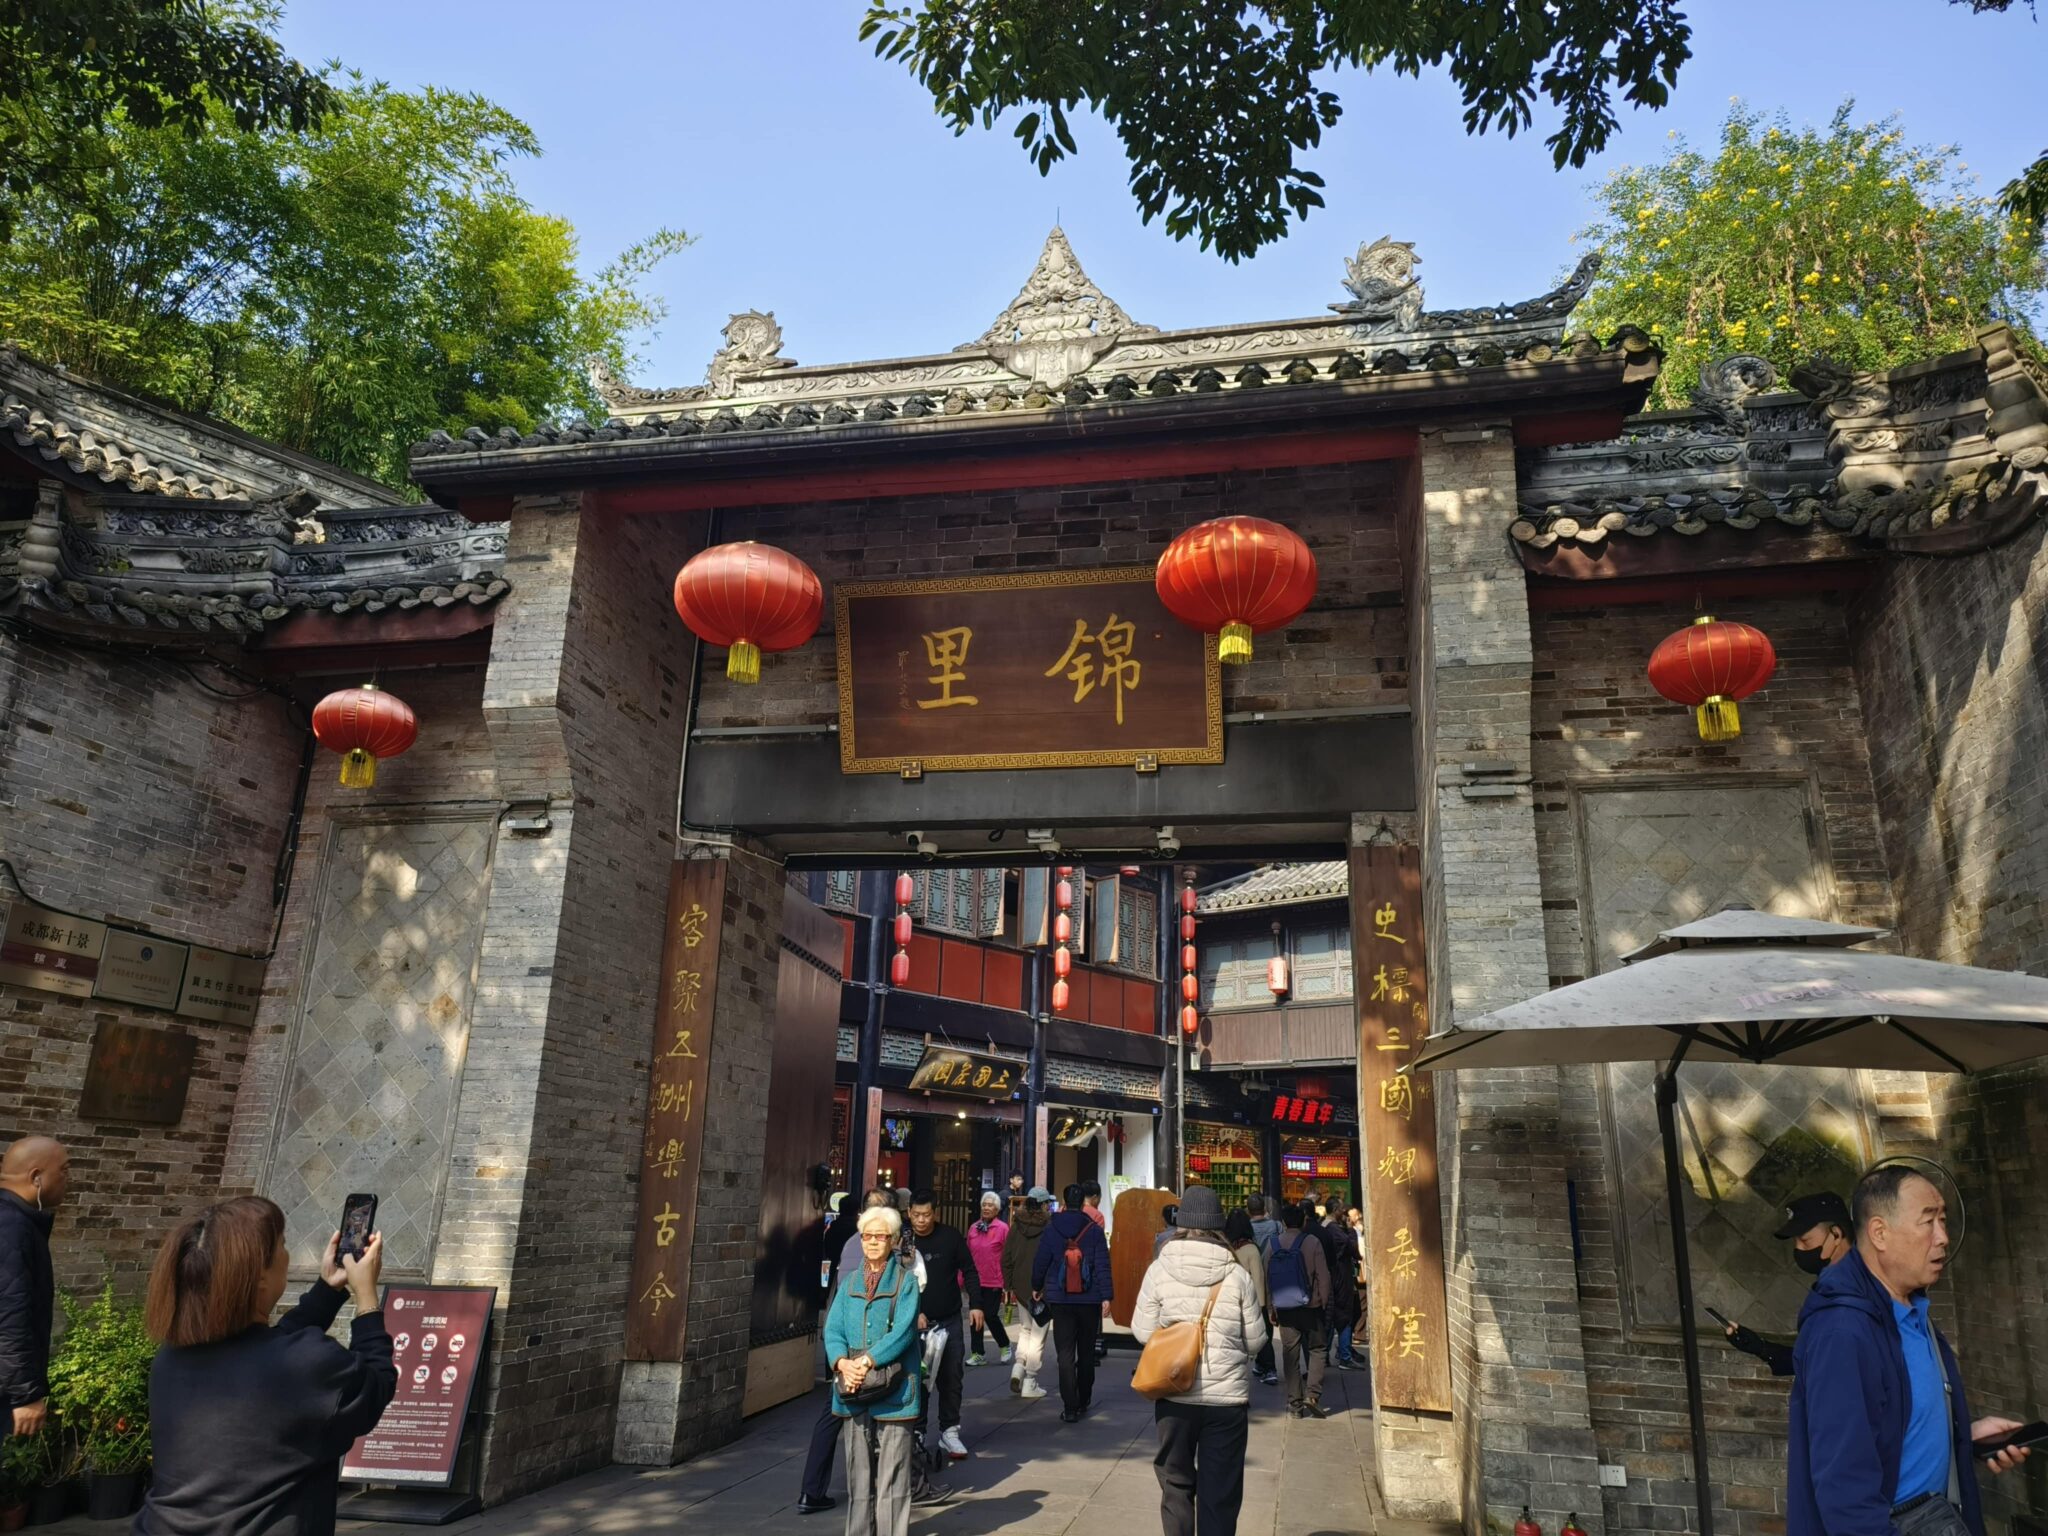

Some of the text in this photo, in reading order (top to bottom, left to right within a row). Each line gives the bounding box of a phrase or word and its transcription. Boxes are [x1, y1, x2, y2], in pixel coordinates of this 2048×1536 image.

[916, 612, 1142, 726] 锦里
[21, 920, 90, 949] 成都新十景
